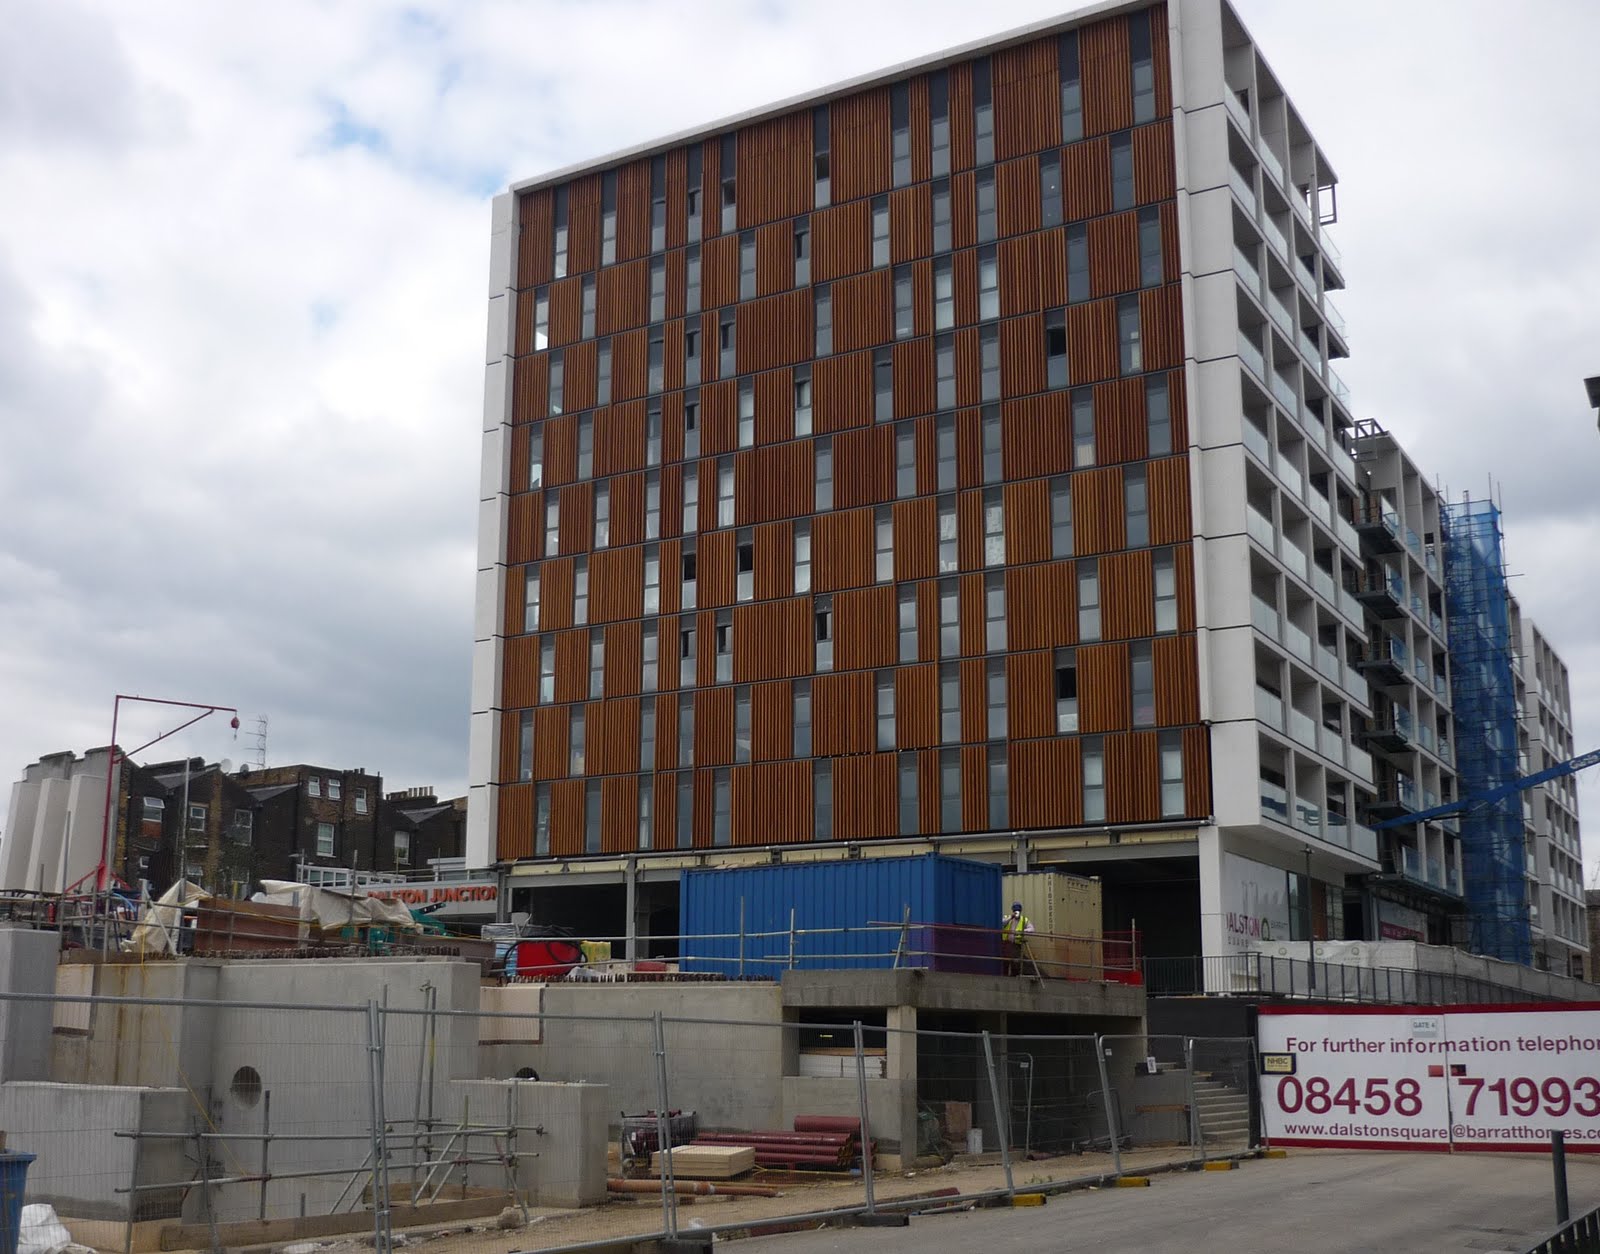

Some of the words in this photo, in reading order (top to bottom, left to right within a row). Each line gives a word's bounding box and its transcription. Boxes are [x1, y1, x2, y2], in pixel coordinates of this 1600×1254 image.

[430, 885, 498, 903] JUNCTION
[1226, 912, 1261, 937] ALSTON
[1413, 1021, 1430, 1029] GATE
[1286, 1037, 1317, 1053] For
[1322, 1037, 1386, 1053] further
[1390, 1036, 1511, 1054] information
[1267, 1057, 1288, 1065] NHBC
[1277, 1076, 1423, 1117] 08458
[1458, 1077, 1600, 1117] 71993
